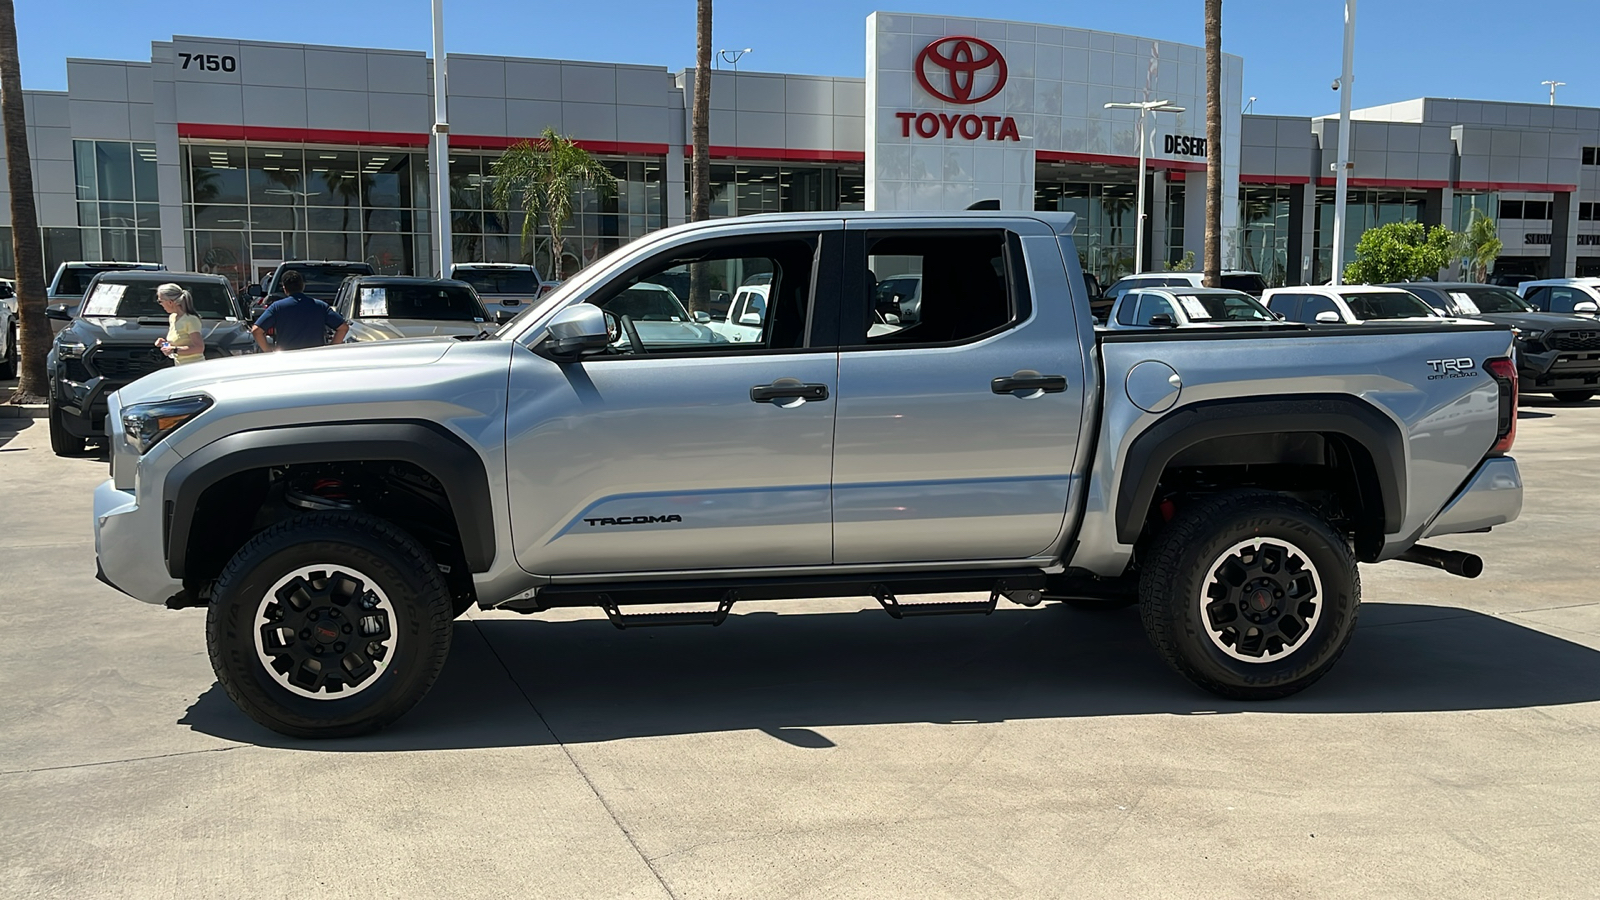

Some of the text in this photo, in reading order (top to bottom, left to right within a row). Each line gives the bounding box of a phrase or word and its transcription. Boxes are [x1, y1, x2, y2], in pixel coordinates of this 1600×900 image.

[178, 52, 237, 73] 7150
[895, 111, 1021, 142] TOYOTA
[1524, 233, 1552, 245] SERV
[1426, 357, 1475, 374] TRD
[583, 514, 682, 527] TACOMA
[317, 626, 338, 638] TRD
